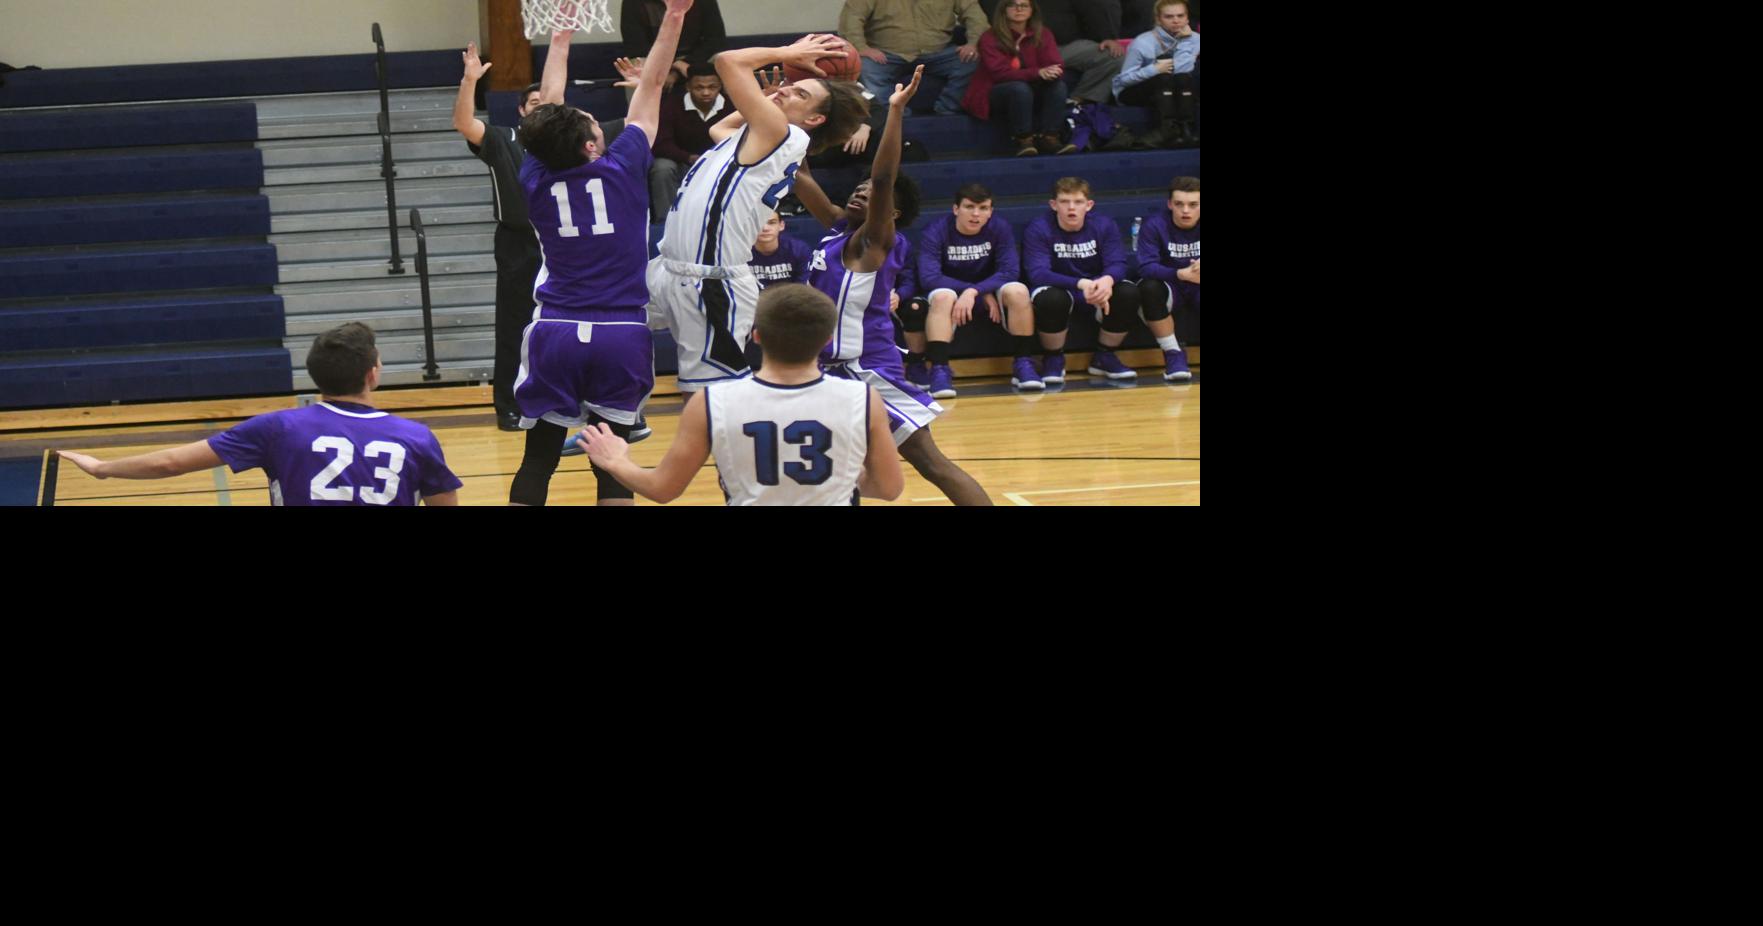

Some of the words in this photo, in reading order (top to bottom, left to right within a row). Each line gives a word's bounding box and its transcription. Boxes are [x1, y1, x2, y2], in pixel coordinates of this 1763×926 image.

[550, 177, 615, 238] 11
[310, 435, 406, 505] 23
[742, 419, 833, 486] 13
